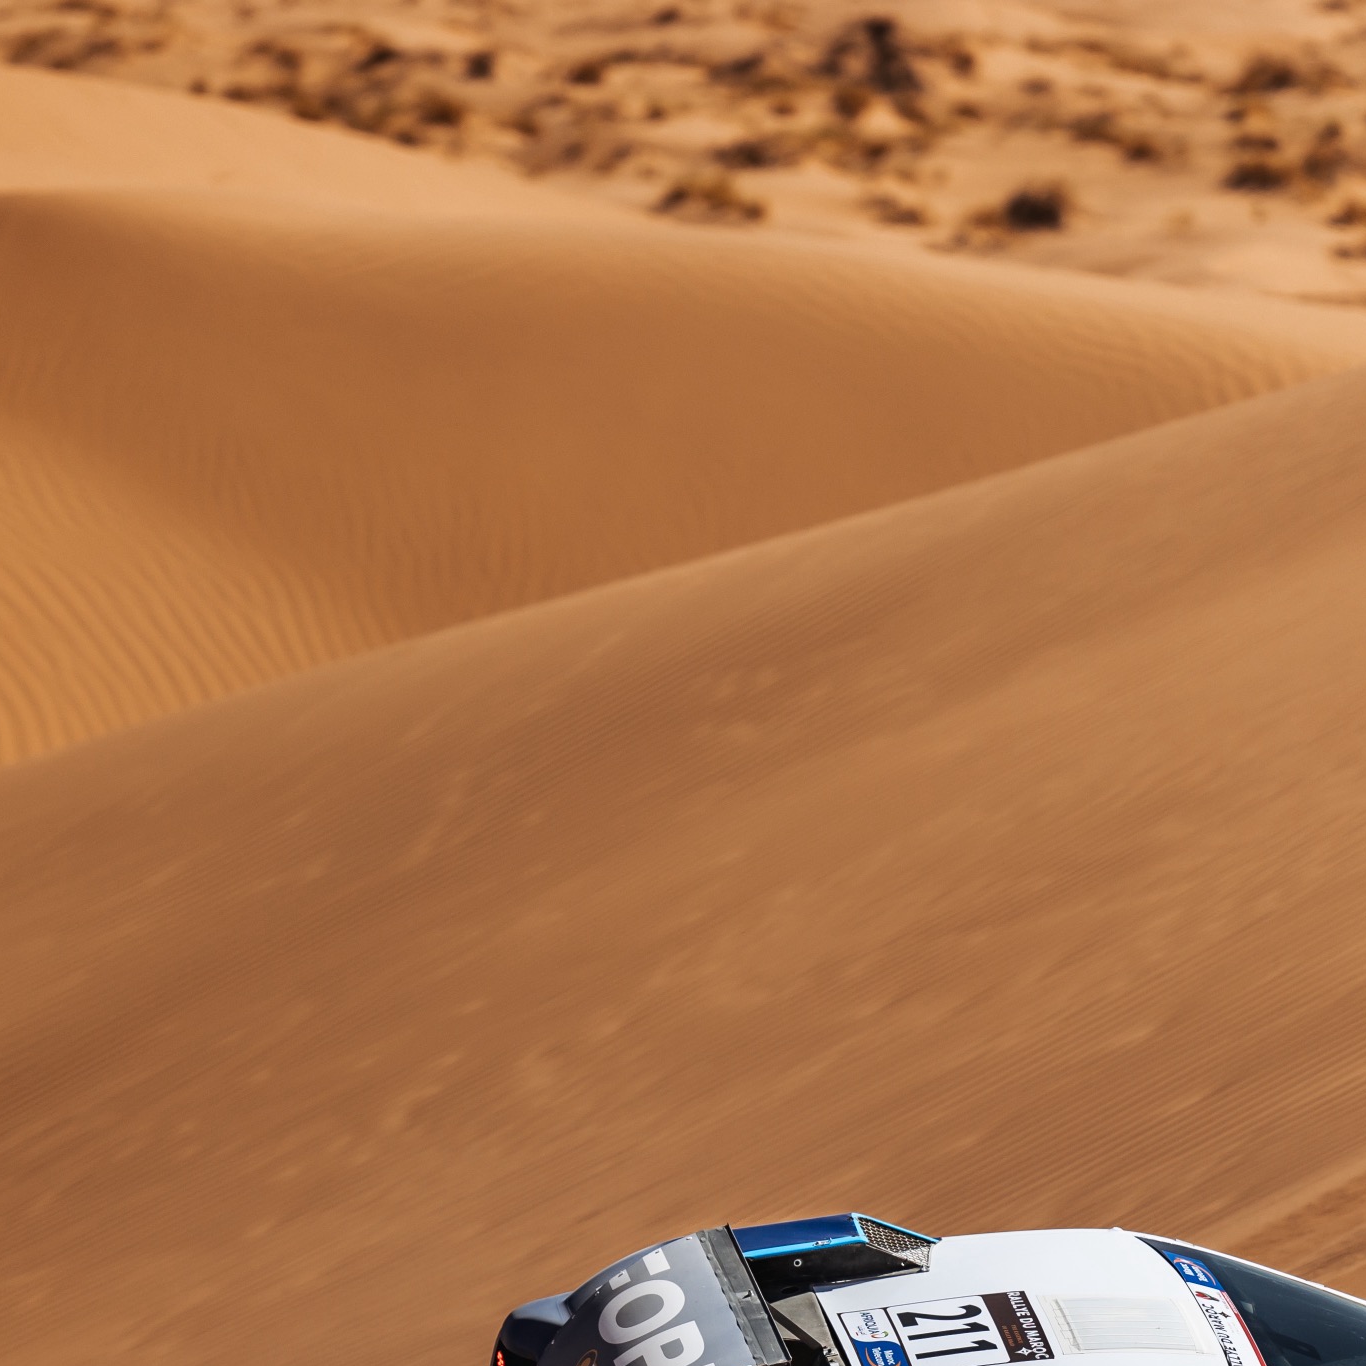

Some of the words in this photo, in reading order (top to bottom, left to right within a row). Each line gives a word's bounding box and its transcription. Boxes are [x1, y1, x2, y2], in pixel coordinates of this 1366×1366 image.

[1007, 1291, 1030, 1317] RALLYE
[897, 1304, 998, 1360] 211
[1019, 1317, 1036, 1329] DU
[1024, 1330, 1049, 1359] MAROC
[1217, 1332, 1233, 1344] DU
